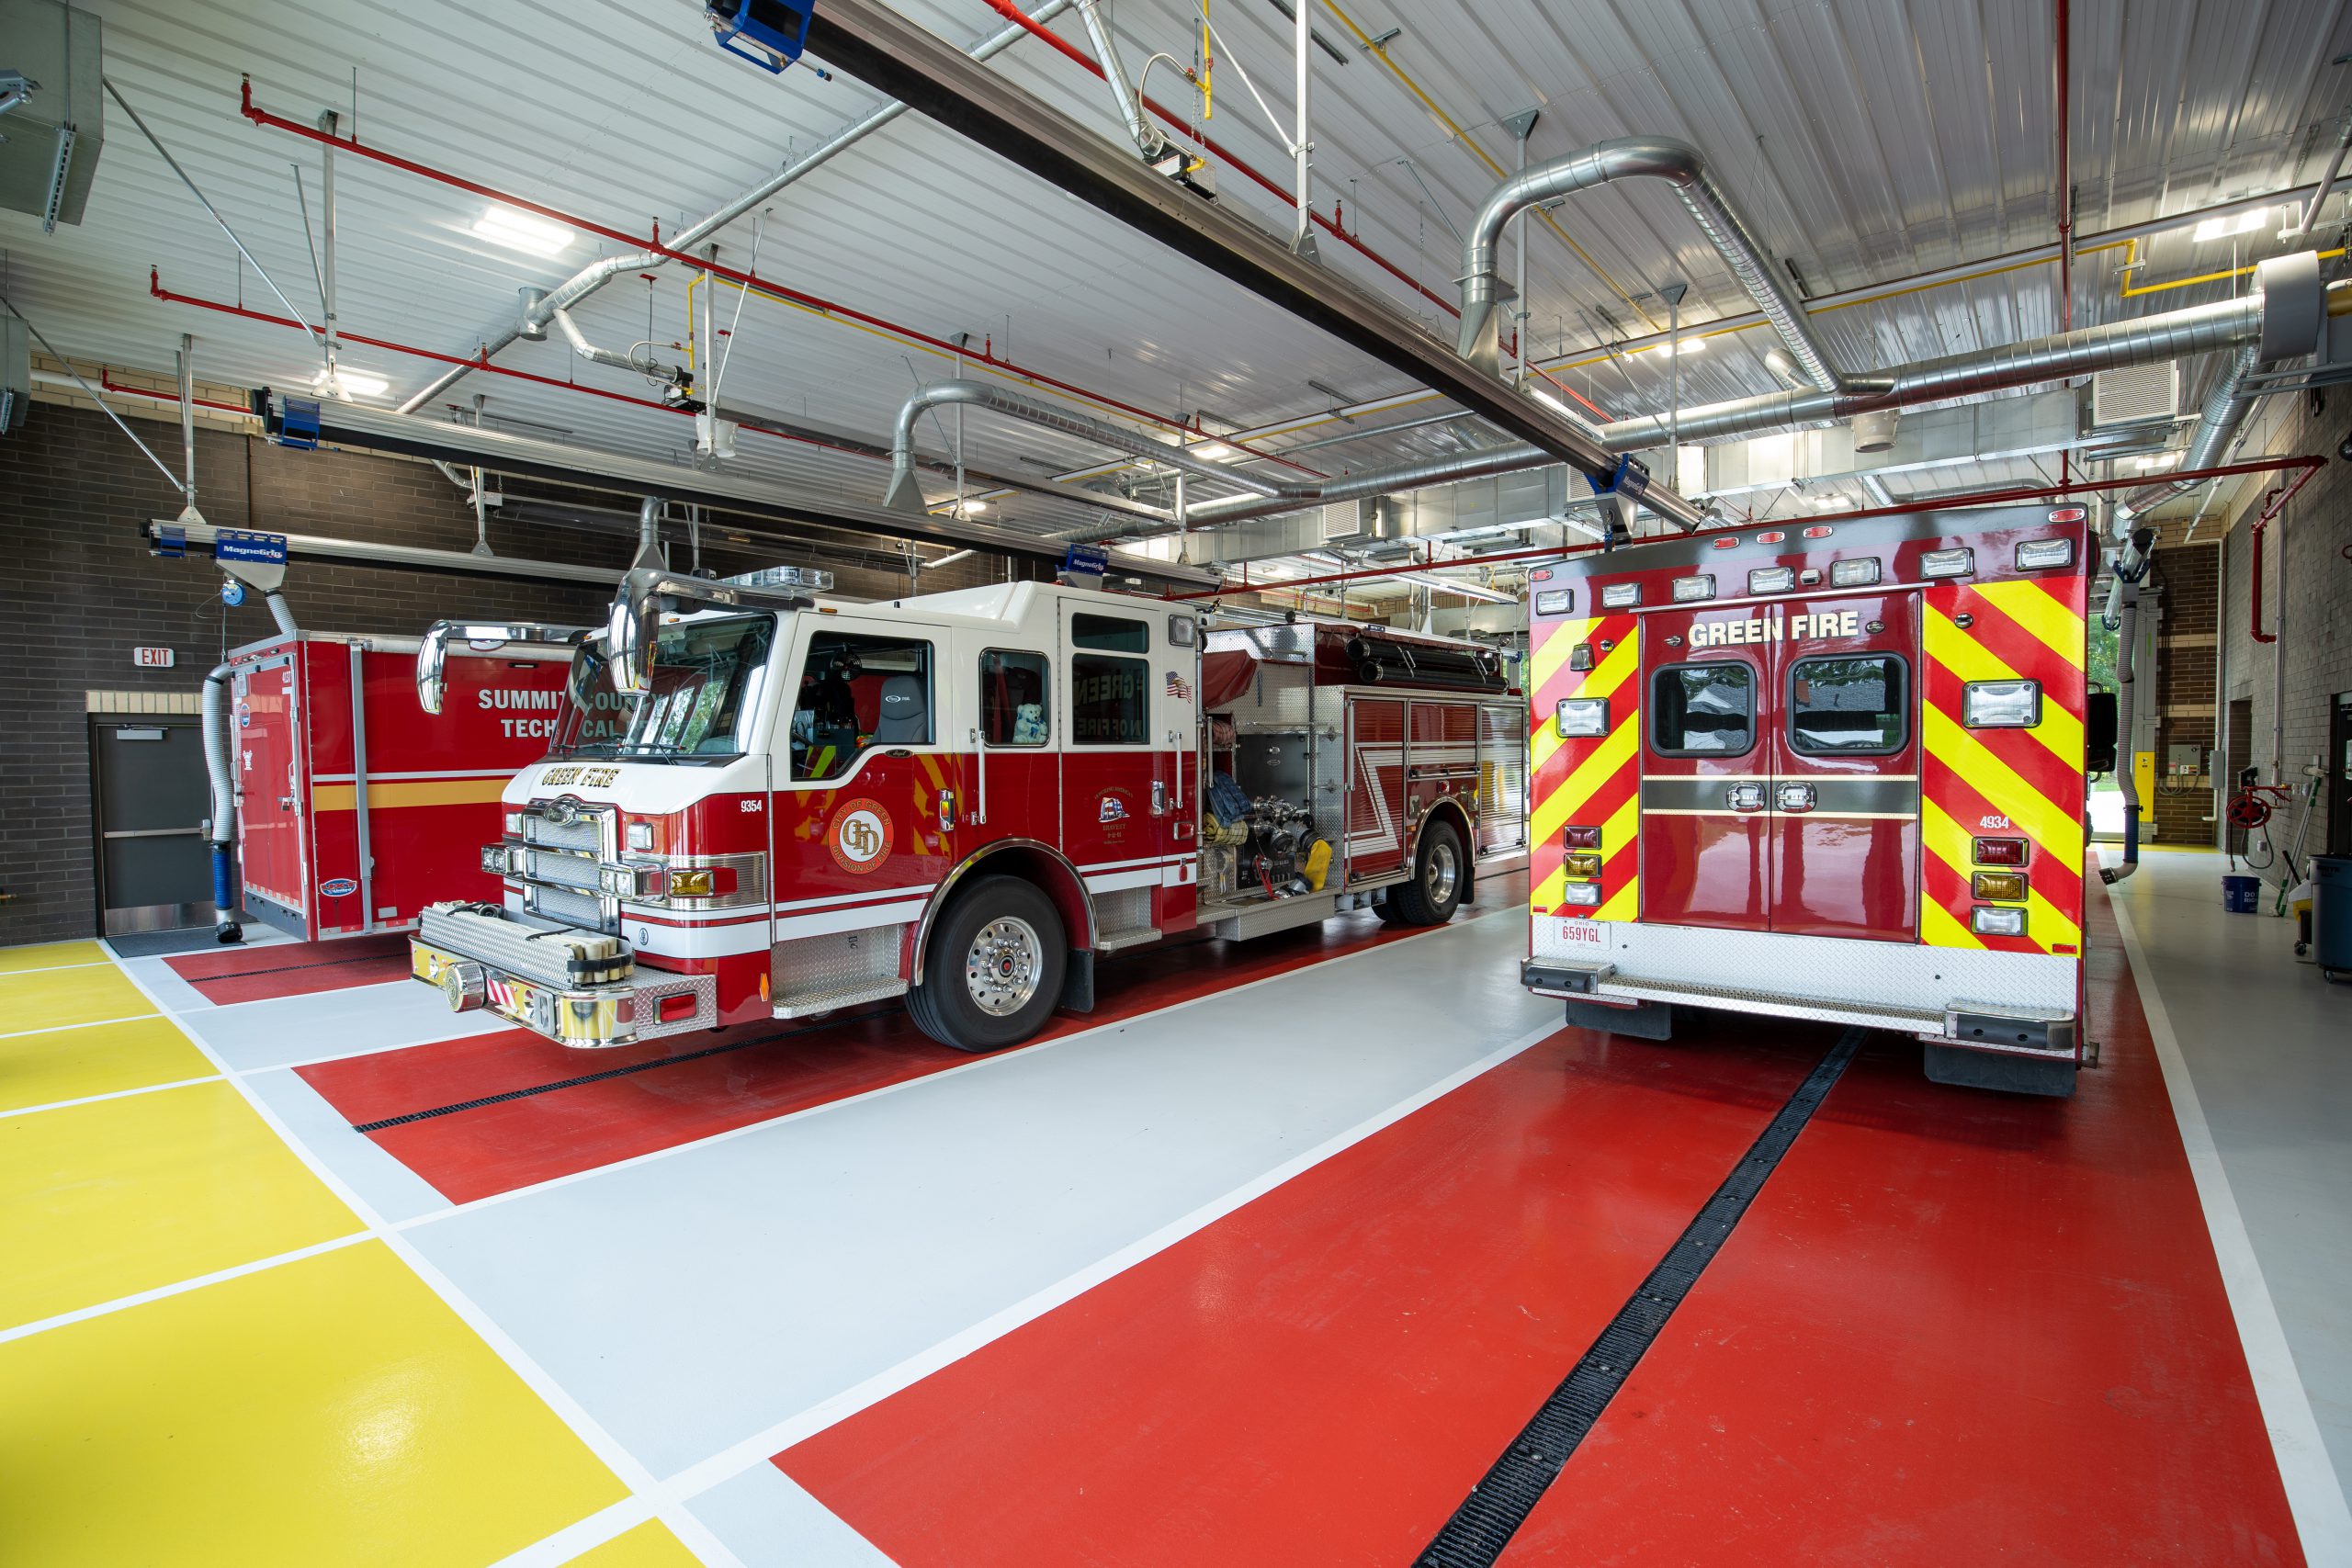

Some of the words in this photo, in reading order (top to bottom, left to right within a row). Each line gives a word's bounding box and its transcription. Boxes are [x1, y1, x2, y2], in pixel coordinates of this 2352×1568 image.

[223, 546, 283, 558] MagneGrip
[1073, 559, 1104, 571] MagneGrip
[1688, 616, 1783, 647] GREEN
[1792, 611, 1859, 639] FIRE
[141, 649, 168, 666] EXIT
[542, 766, 585, 785] GREEN
[580, 767, 621, 788] FIRE
[741, 799, 763, 813] 9354
[832, 808, 848, 829] CITY
[849, 800, 863, 810] OF
[865, 800, 890, 827] GREEN
[1979, 815, 2009, 829] 4934
[831, 845, 864, 872] DIVISION
[865, 860, 878, 871] OF
[877, 840, 891, 863] FIRE
[1563, 926, 1600, 942] 659YGL
